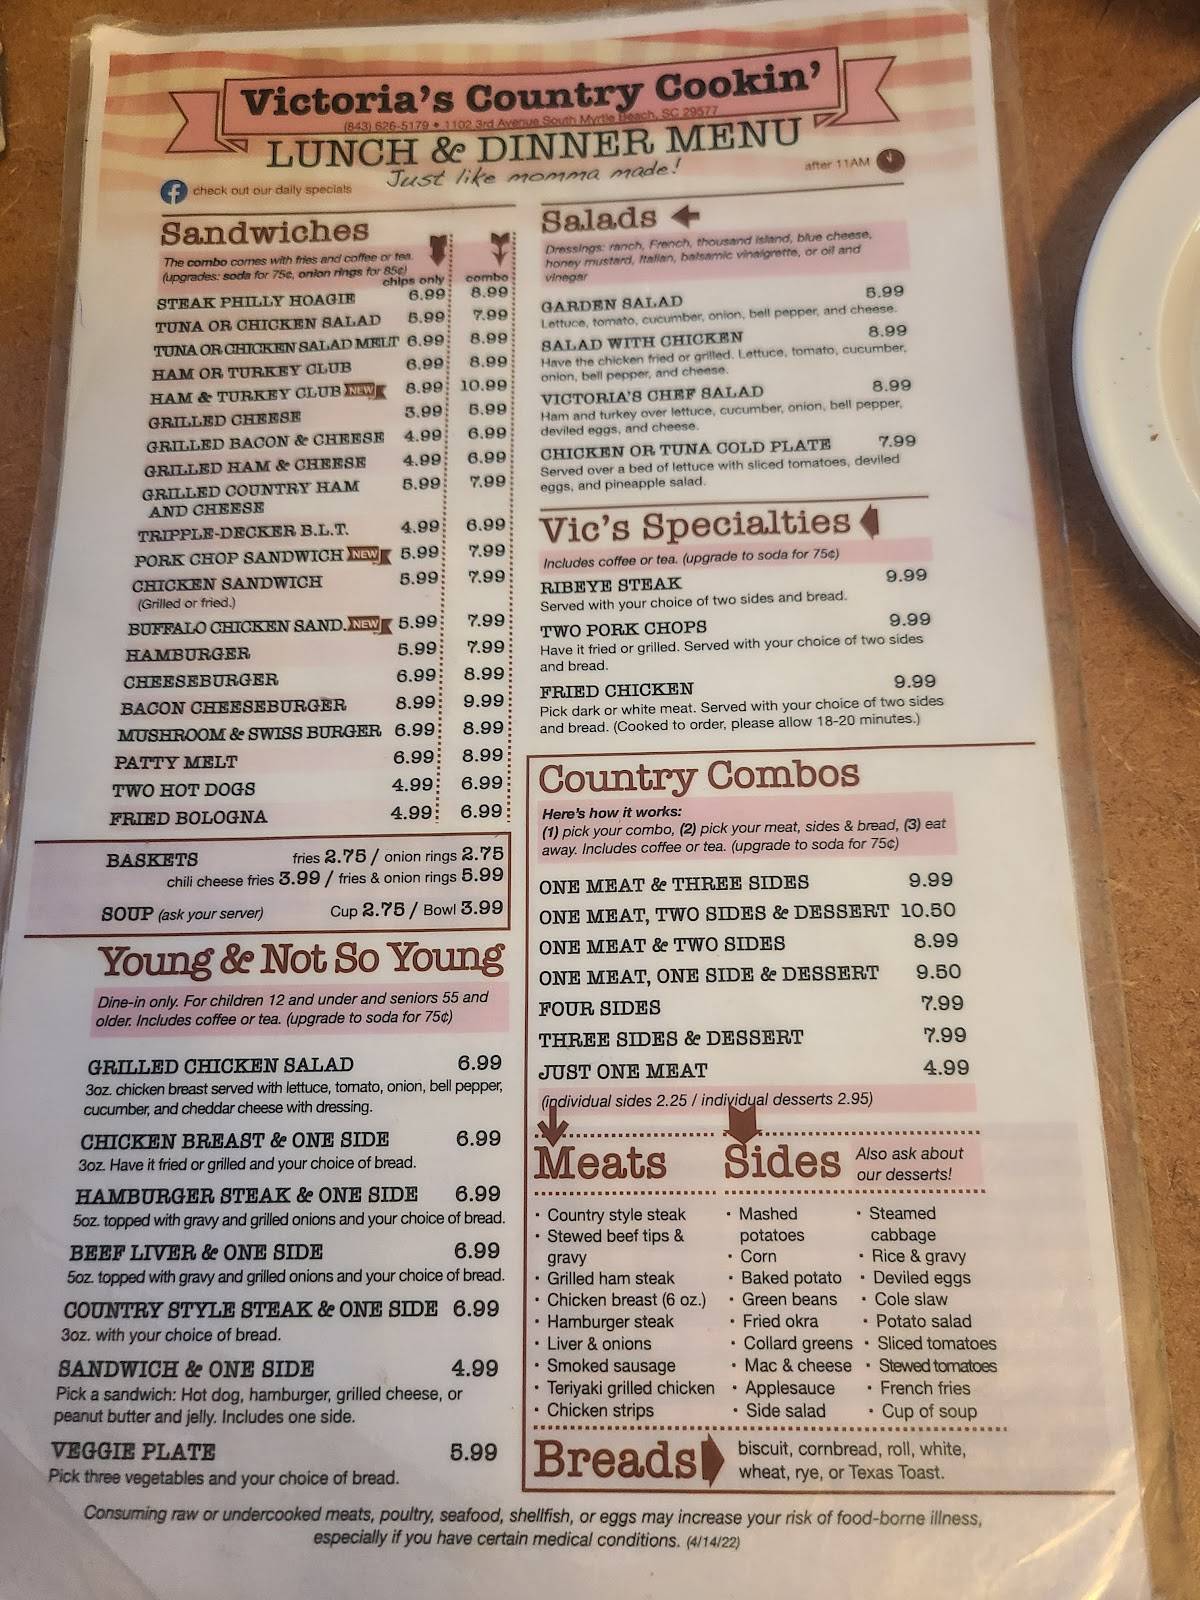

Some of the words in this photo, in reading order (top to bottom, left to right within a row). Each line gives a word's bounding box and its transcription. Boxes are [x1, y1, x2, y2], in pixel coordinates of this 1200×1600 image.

[240, 83, 455, 117] Victoria's
[466, 82, 645, 114] Country
[655, 60, 821, 102] Cookin'
[344, 121, 371, 133] (843)
[375, 120, 429, 131] 626-5179
[445, 119, 472, 129] 1102
[475, 118, 494, 129] 3rd
[497, 117, 540, 128] Avenue
[543, 115, 577, 126] South
[580, 113, 615, 126] Myrtle
[662, 108, 679, 118] SC
[683, 105, 719, 117] 29577
[266, 138, 419, 168] LUNCH
[431, 136, 466, 164] &
[477, 128, 654, 163] DINNER
[665, 117, 802, 154] MENU
[386, 169, 445, 187] Just
[455, 166, 495, 185] like
[507, 168, 599, 183] momma
[610, 158, 681, 178] made!
[804, 160, 832, 170] after
[836, 157, 870, 168] 11AM
[192, 185, 227, 195] check
[231, 186, 249, 195] out
[252, 187, 272, 195] our
[275, 184, 302, 196] daily
[305, 184, 352, 196] specials
[541, 206, 657, 233] Salads
[160, 220, 369, 246] Sandwiches
[545, 243, 605, 254] Dressings:
[609, 241, 644, 251] ranch,
[649, 238, 691, 249] French,
[697, 235, 752, 246] thousand
[755, 233, 792, 244] island,
[796, 232, 822, 242] blue
[825, 231, 872, 241] cheese,
[163, 257, 184, 267] The
[186, 257, 228, 267] combo
[230, 257, 267, 266] comes
[270, 255, 292, 264] with
[295, 255, 318, 264] fries
[320, 254, 342, 264] and
[343, 252, 377, 262] coffee
[156, 297, 216, 310] STEAK
[220, 295, 284, 308] PHILLY
[289, 292, 355, 306] HOAGIE
[408, 288, 445, 300] 6.99
[471, 286, 508, 298] 8.99
[541, 298, 616, 313] GARDEN
[622, 295, 682, 309] SALAD
[866, 285, 904, 298] 5.99
[541, 339, 602, 352] SALAD
[607, 336, 655, 349] WITH
[660, 331, 743, 347] CHICKEN
[868, 324, 907, 337] 8.99
[150, 392, 193, 405] HAM
[197, 391, 212, 403] &
[217, 388, 291, 402] TURKEY
[295, 386, 341, 399] CLUB
[349, 385, 373, 394] NEW
[405, 380, 443, 394] 8.99
[461, 379, 507, 391] 10.99
[148, 414, 226, 429] GRILLED
[231, 410, 301, 425] CHEESE
[404, 404, 442, 418] 3.99
[469, 403, 506, 415] 5.99
[137, 524, 296, 542] TRIPPLE-DECKER
[300, 523, 349, 536] B.L.T.
[400, 519, 439, 533] 4.99
[466, 517, 505, 531] 6.99
[538, 514, 629, 543] Vic's
[643, 509, 850, 544] Specialties
[540, 579, 611, 594] RIBEYE
[618, 576, 682, 592] STEAK
[886, 568, 927, 582] 9.99
[538, 763, 699, 797] Country
[707, 760, 860, 789] Combos
[109, 811, 170, 826] FRIED
[174, 809, 268, 825] BOLOGNA
[390, 805, 432, 819] 4.99
[460, 803, 502, 818] 6.99
[542, 807, 585, 820] Here's
[588, 807, 619, 818] how
[622, 806, 632, 818] it
[635, 805, 682, 817] works:
[105, 852, 198, 867] BASKETS
[292, 852, 320, 864] fries
[324, 848, 366, 863] 2.75
[370, 848, 379, 866] /
[384, 850, 420, 862] onion
[425, 850, 457, 864] rings
[461, 845, 503, 861] 2.75
[539, 879, 579, 894] ONE
[585, 878, 645, 893] MEAT
[650, 877, 667, 891] &
[672, 876, 742, 891] THREE
[748, 874, 809, 890] SIDES
[909, 871, 952, 887] 9.99
[539, 909, 580, 924] ONE
[585, 907, 649, 925] MEAT,
[655, 906, 699, 922] TWO
[706, 905, 766, 921] SIDES
[772, 905, 788, 919] &
[793, 903, 889, 919] DESSERT
[900, 902, 955, 917] 10.50
[97, 946, 215, 982] Young
[219, 943, 254, 974] &
[259, 943, 327, 974] Not
[334, 942, 379, 973] So
[386, 941, 505, 977] Young
[88, 1059, 179, 1075] GRILLED
[184, 1057, 279, 1074] CHICKEN
[283, 1056, 354, 1073] SALAD
[457, 1054, 501, 1070] 6.99
[533, 1145, 666, 1179] Meats
[724, 1144, 841, 1178] Sides
[855, 1146, 887, 1160] Also
[891, 1146, 916, 1160] ask
[920, 1146, 964, 1160] about
[857, 1170, 882, 1181] our
[885, 1167, 952, 1181] desserts!
[547, 1207, 604, 1224] Country
[609, 1207, 642, 1224] style
[647, 1207, 686, 1221] steak
[739, 1206, 797, 1220] Mashed
[869, 1206, 936, 1220] Steamed
[873, 1270, 928, 1284] Deviled
[934, 1273, 971, 1287] eggs
[882, 1403, 914, 1421] Cup
[919, 1403, 934, 1418] of
[939, 1406, 977, 1422] soup
[50, 1441, 135, 1460] VEGGIE
[141, 1442, 215, 1461] PLATE
[450, 1442, 497, 1461] 5.99
[533, 1439, 696, 1479] Breads
[738, 1440, 792, 1457] biscuit,
[798, 1440, 881, 1458] cornbread,
[887, 1441, 914, 1458] roll,
[919, 1441, 965, 1458] white,
[313, 1529, 388, 1547] especially
[391, 1528, 402, 1545] if
[404, 1532, 433, 1548] you
[436, 1529, 472, 1545] have
[477, 1530, 528, 1545] certain
[532, 1531, 593, 1546] medical
[597, 1531, 680, 1548] conditions.
[686, 1535, 740, 1550] (4/14/22)
